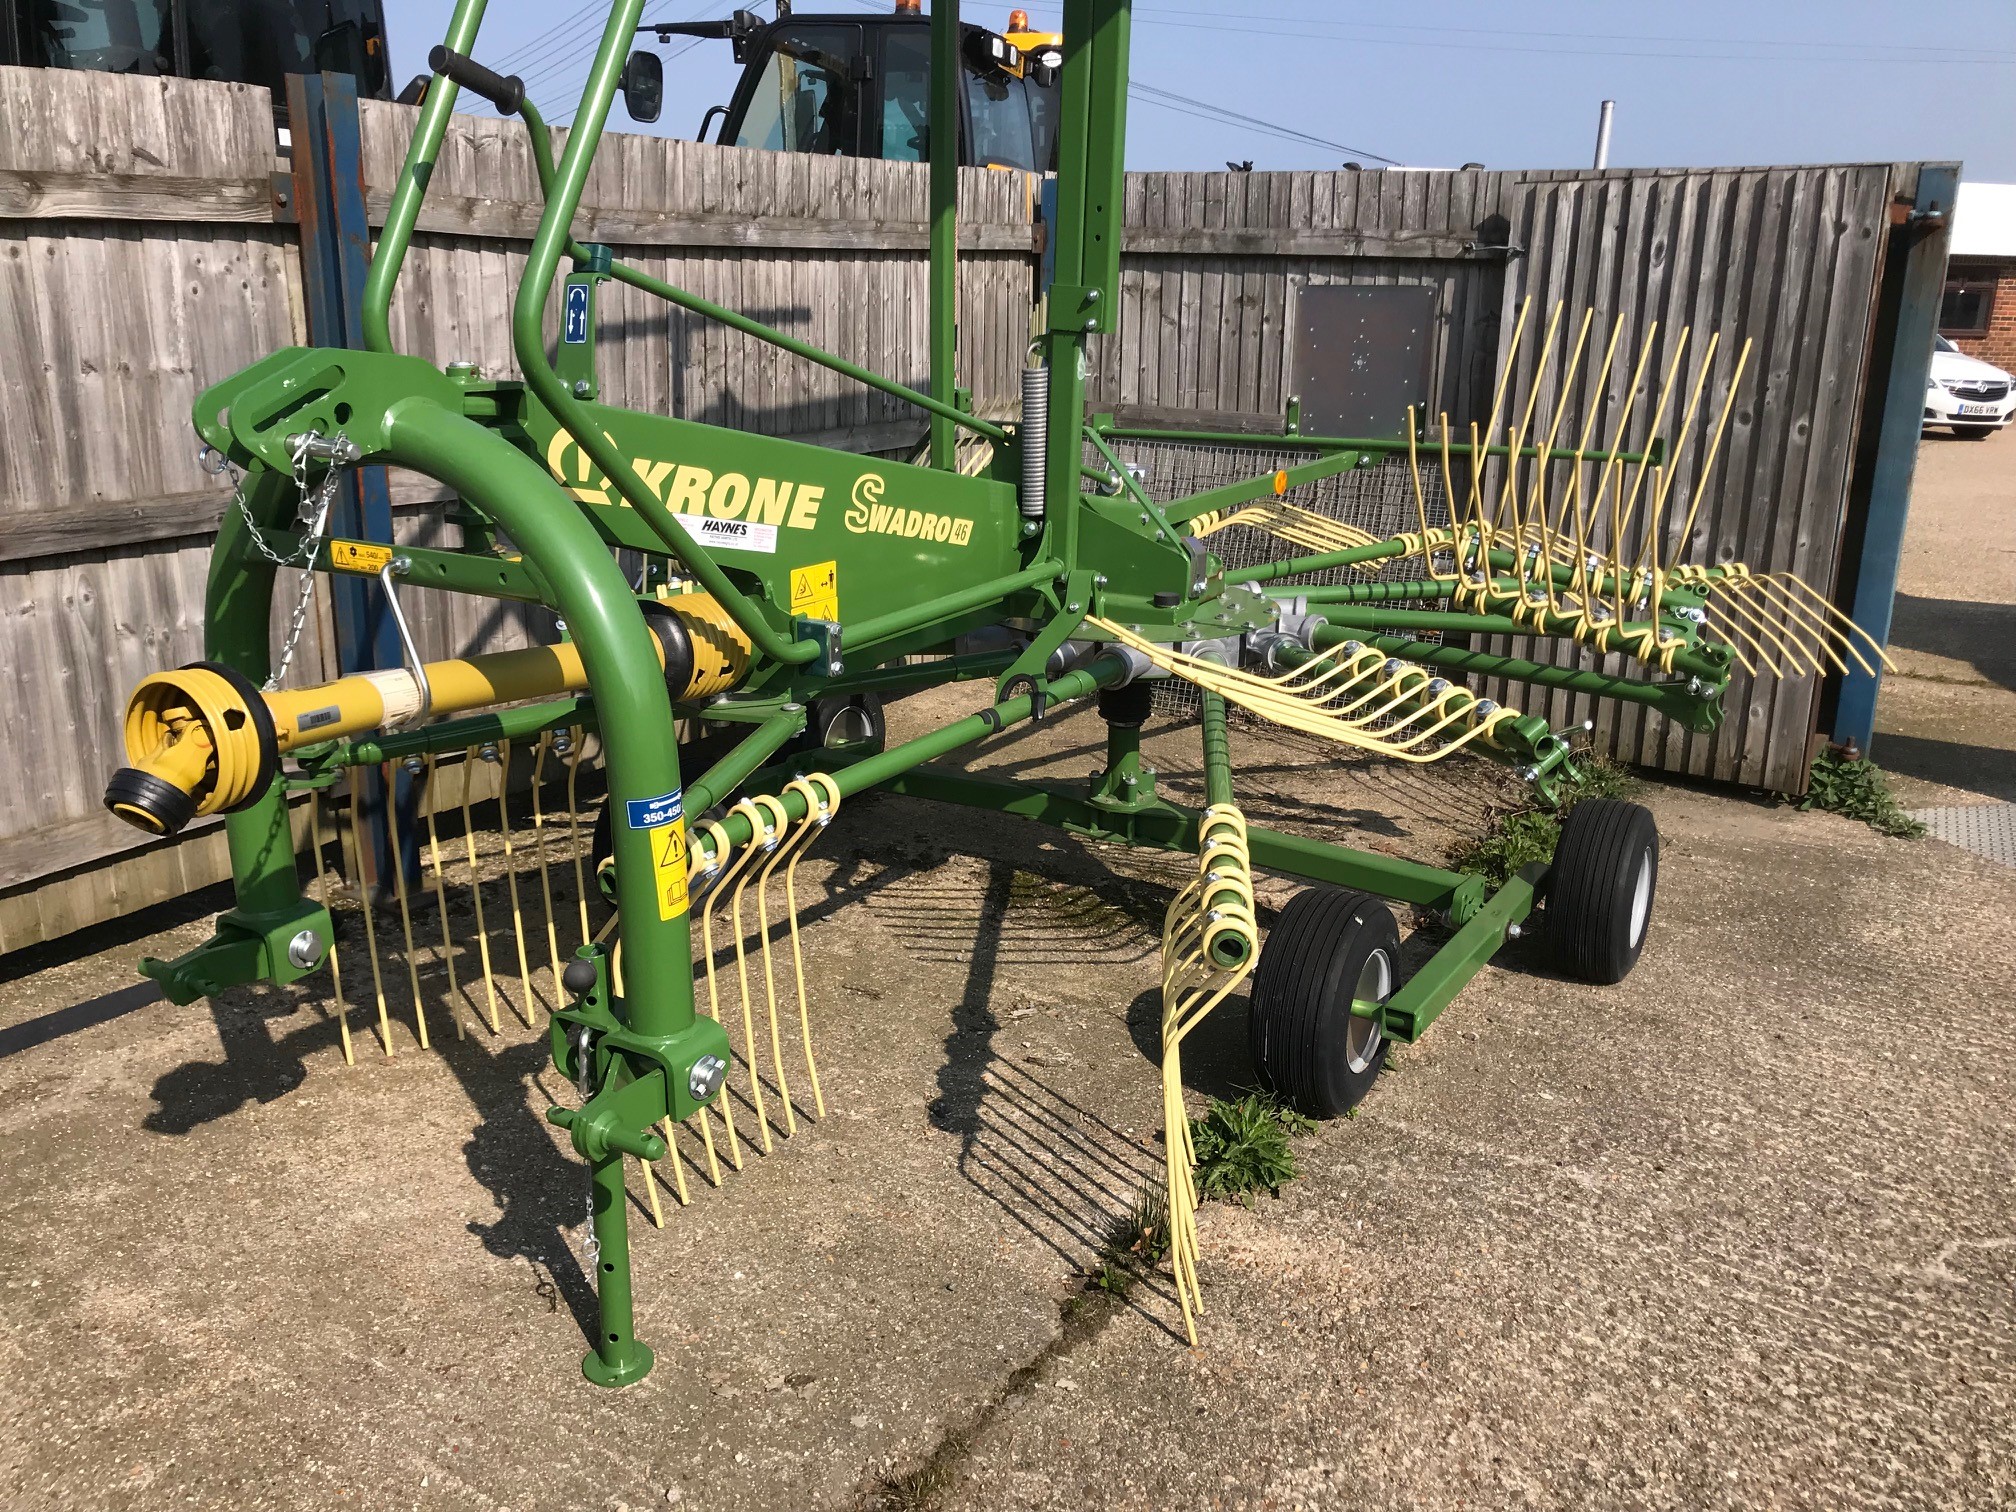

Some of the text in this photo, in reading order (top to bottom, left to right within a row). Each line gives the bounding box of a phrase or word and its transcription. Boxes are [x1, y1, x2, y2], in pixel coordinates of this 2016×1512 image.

[1963, 405, 1984, 414] DX66
[620, 458, 825, 530] KRONE
[844, 473, 968, 543] SWADRO 46
[701, 519, 748, 536] HAYNES
